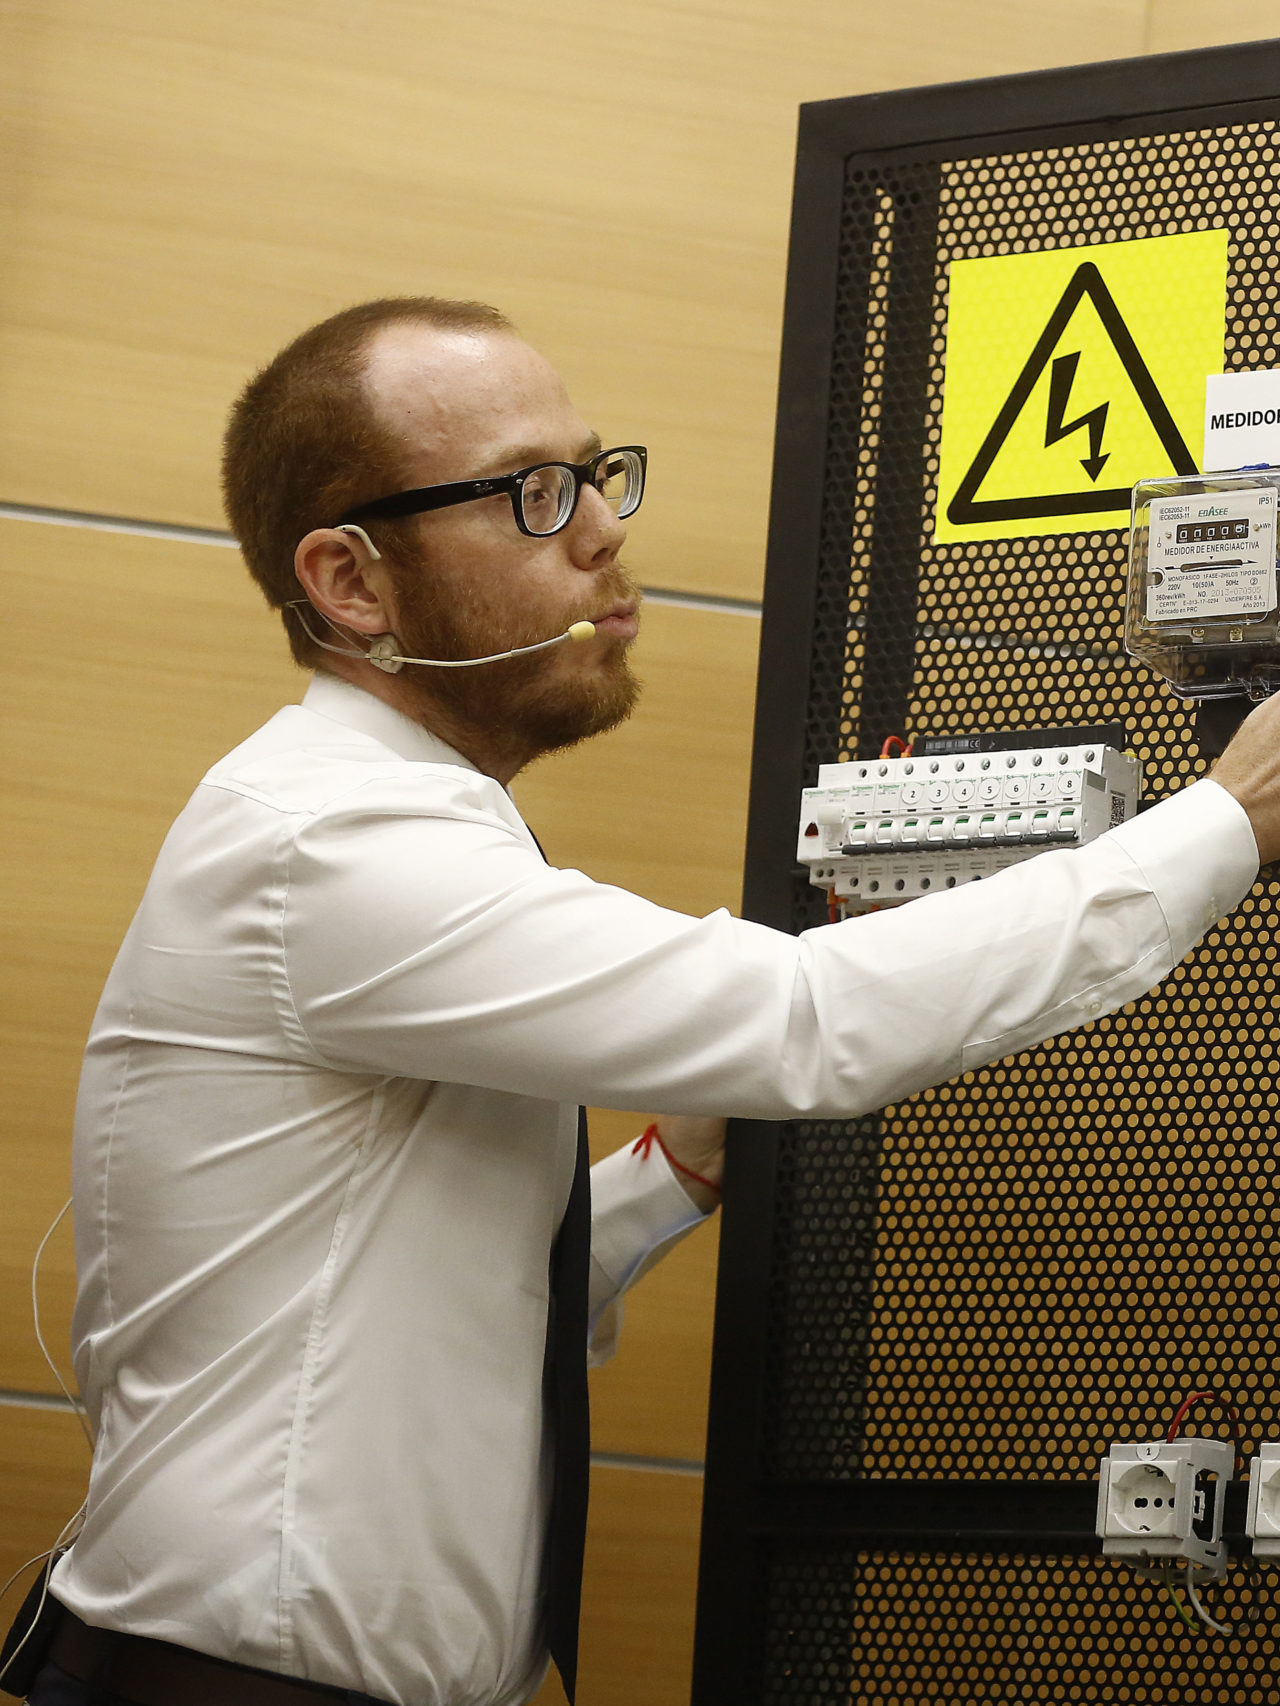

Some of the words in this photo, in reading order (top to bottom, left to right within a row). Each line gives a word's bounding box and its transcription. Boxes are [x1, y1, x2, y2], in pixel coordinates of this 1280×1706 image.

[1258, 497, 1273, 505] IP51
[1165, 546, 1195, 556] MEDIDOR
[1196, 545, 1204, 554] DE
[1168, 583, 1181, 591] 220V
[1225, 579, 1239, 587] 50Hz
[1155, 608, 1179, 616] Fabricado
[1040, 783, 1046, 791] 7
[1067, 780, 1072, 788] 8
[910, 790, 916, 798] 2
[935, 789, 941, 797] 3
[987, 786, 992, 794] 5
[1146, 1447, 1151, 1456] 1
